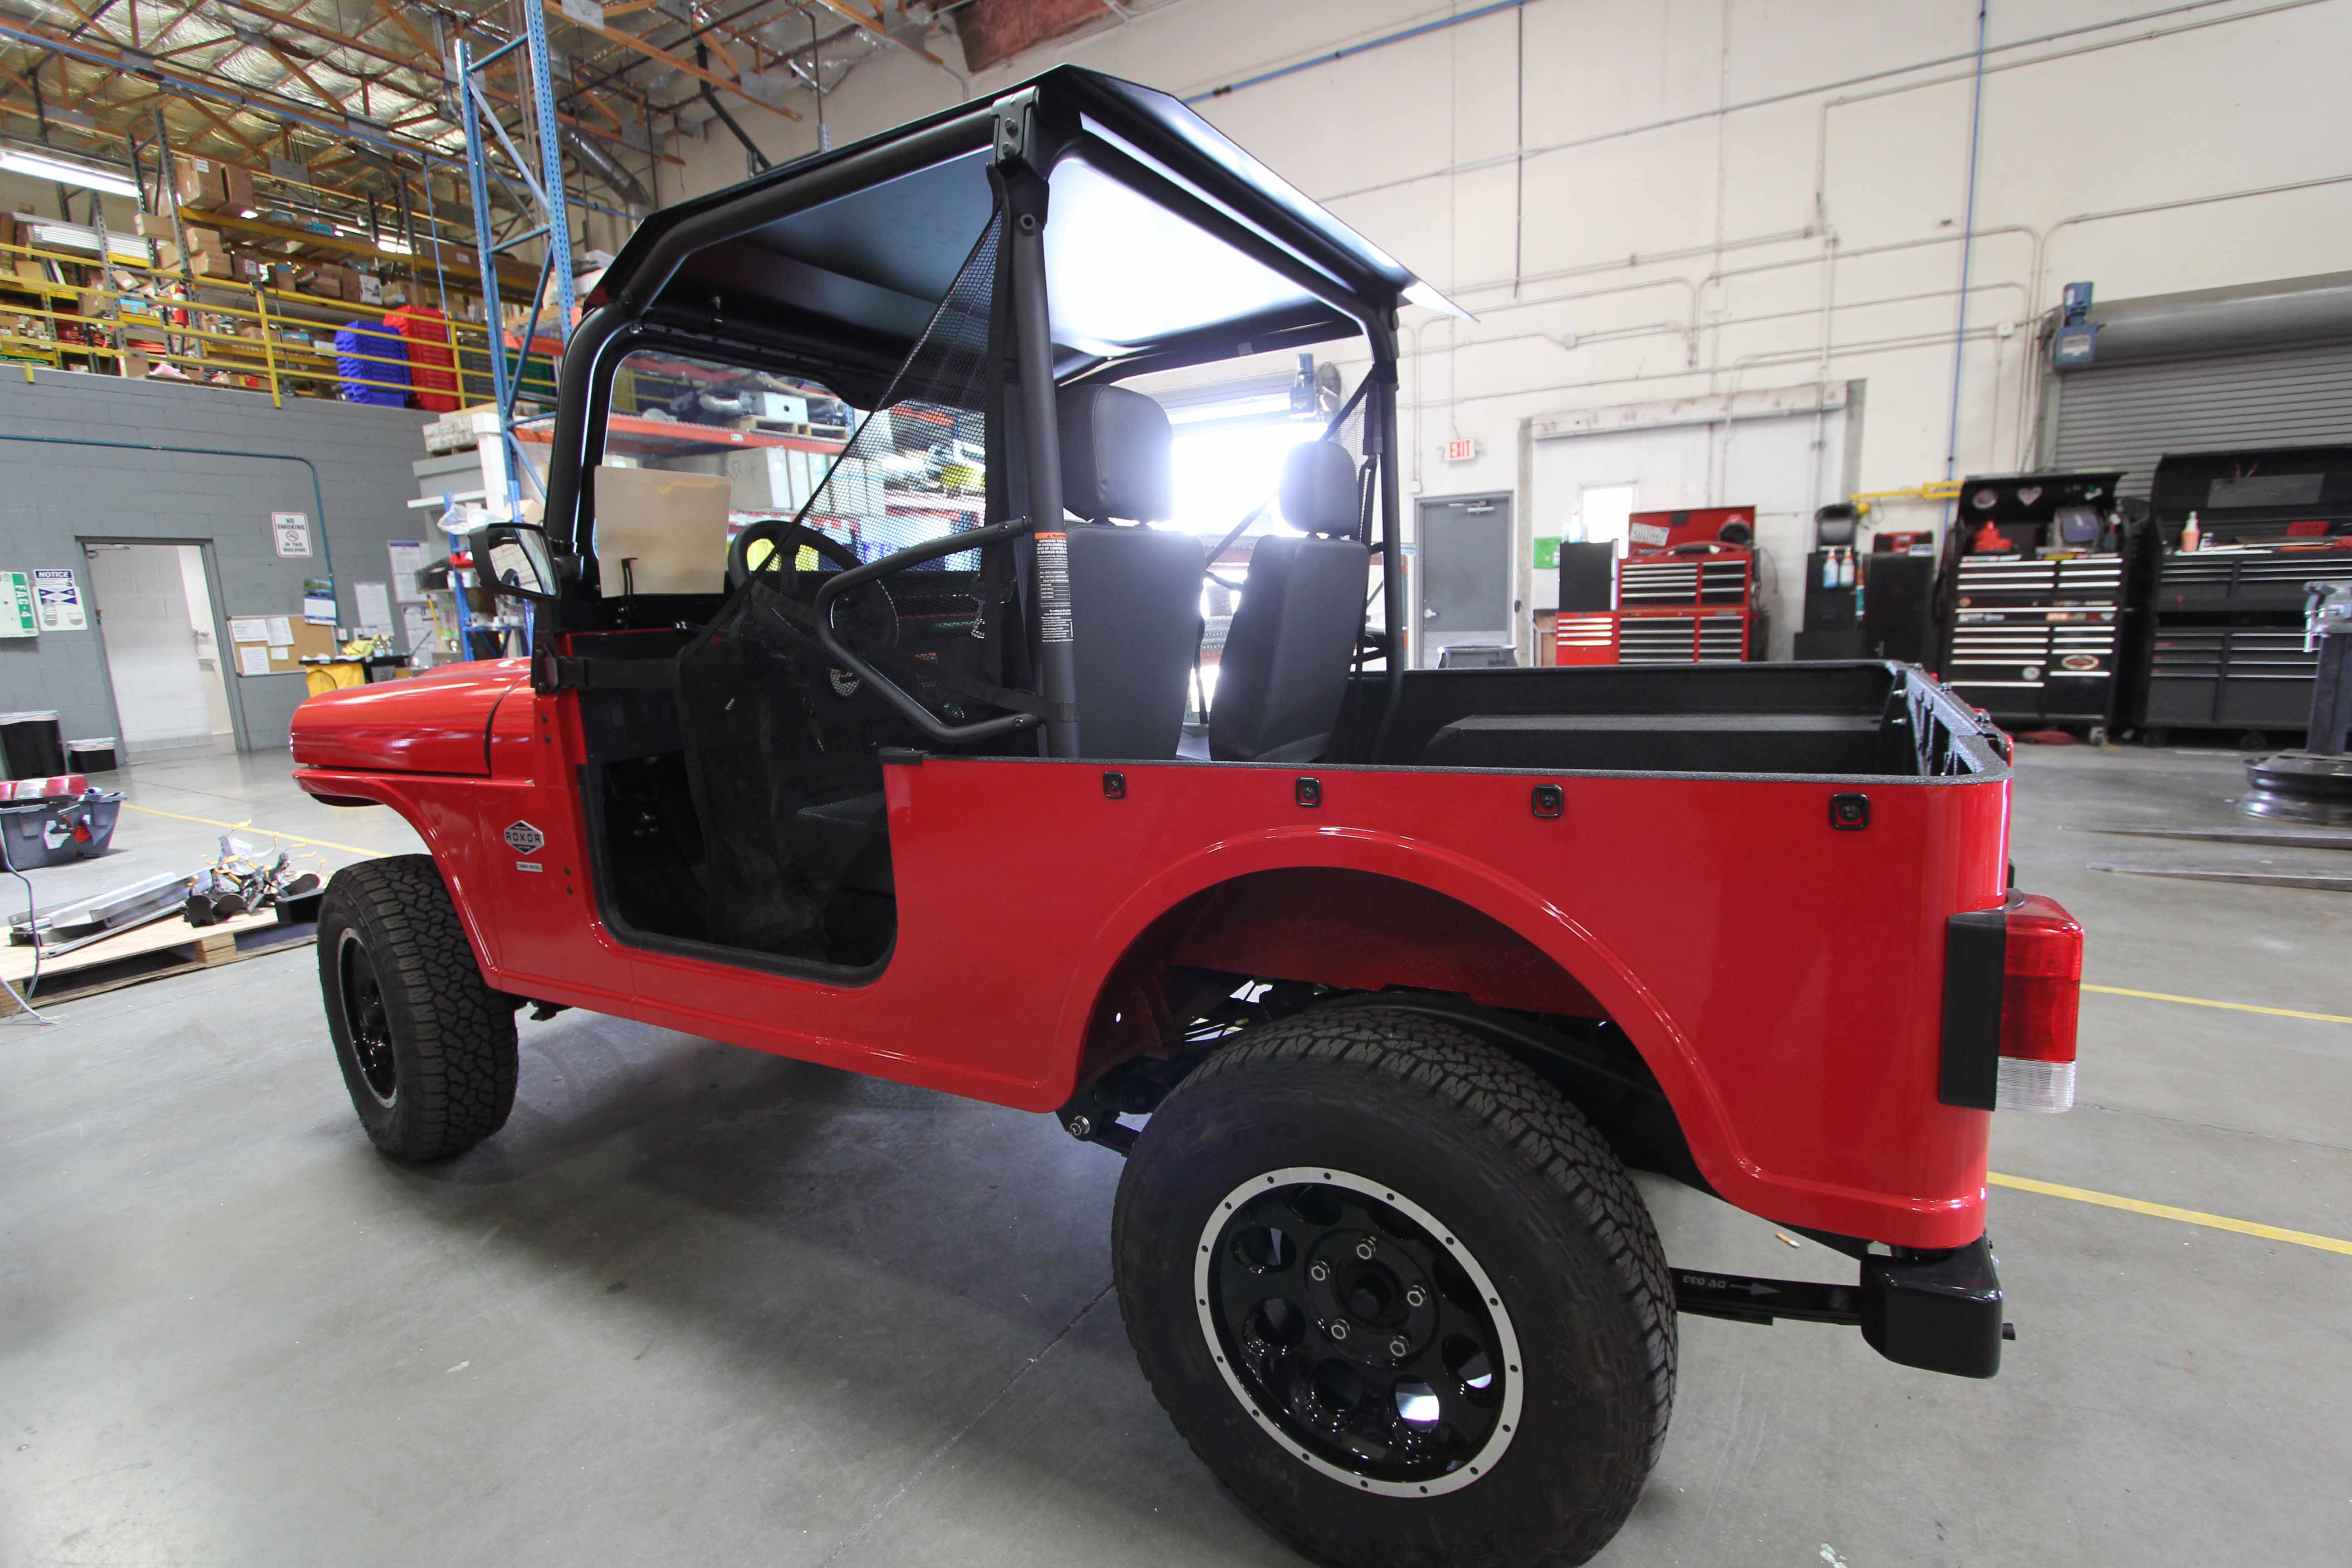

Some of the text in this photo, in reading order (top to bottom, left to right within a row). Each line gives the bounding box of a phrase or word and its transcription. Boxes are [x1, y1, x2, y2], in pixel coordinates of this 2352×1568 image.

[1450, 440, 1470, 458] EXIT
[15, 585, 32, 617] FAC-4
[505, 832, 541, 843] ROXOR
